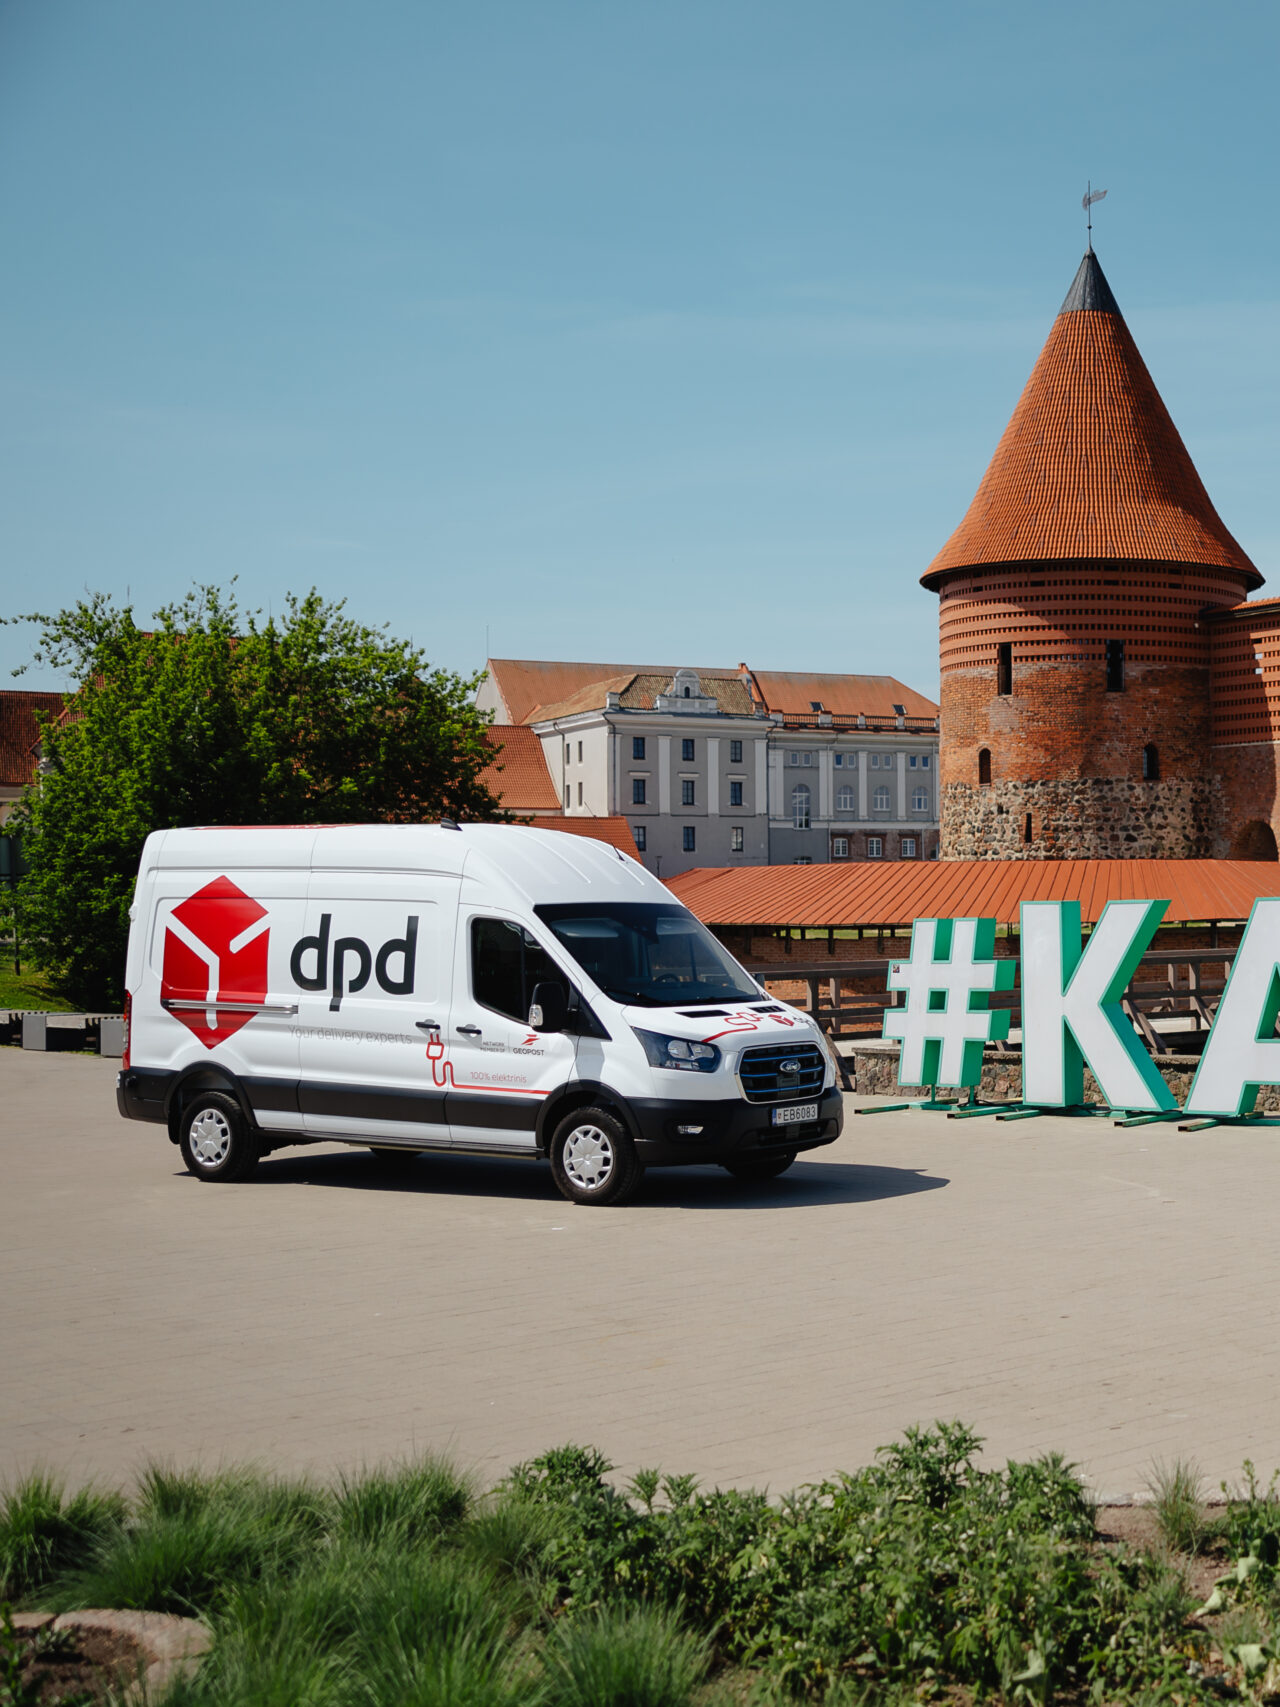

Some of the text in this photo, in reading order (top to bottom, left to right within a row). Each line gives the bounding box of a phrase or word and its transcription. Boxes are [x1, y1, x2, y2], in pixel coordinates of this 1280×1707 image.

[290, 913, 419, 1012] dpd
[288, 1025, 413, 1046] Your delivery experts
[513, 1047, 545, 1056] GEOPOST
[470, 1071, 528, 1083] 100% elektrinis
[783, 1105, 816, 1122] EB6083
